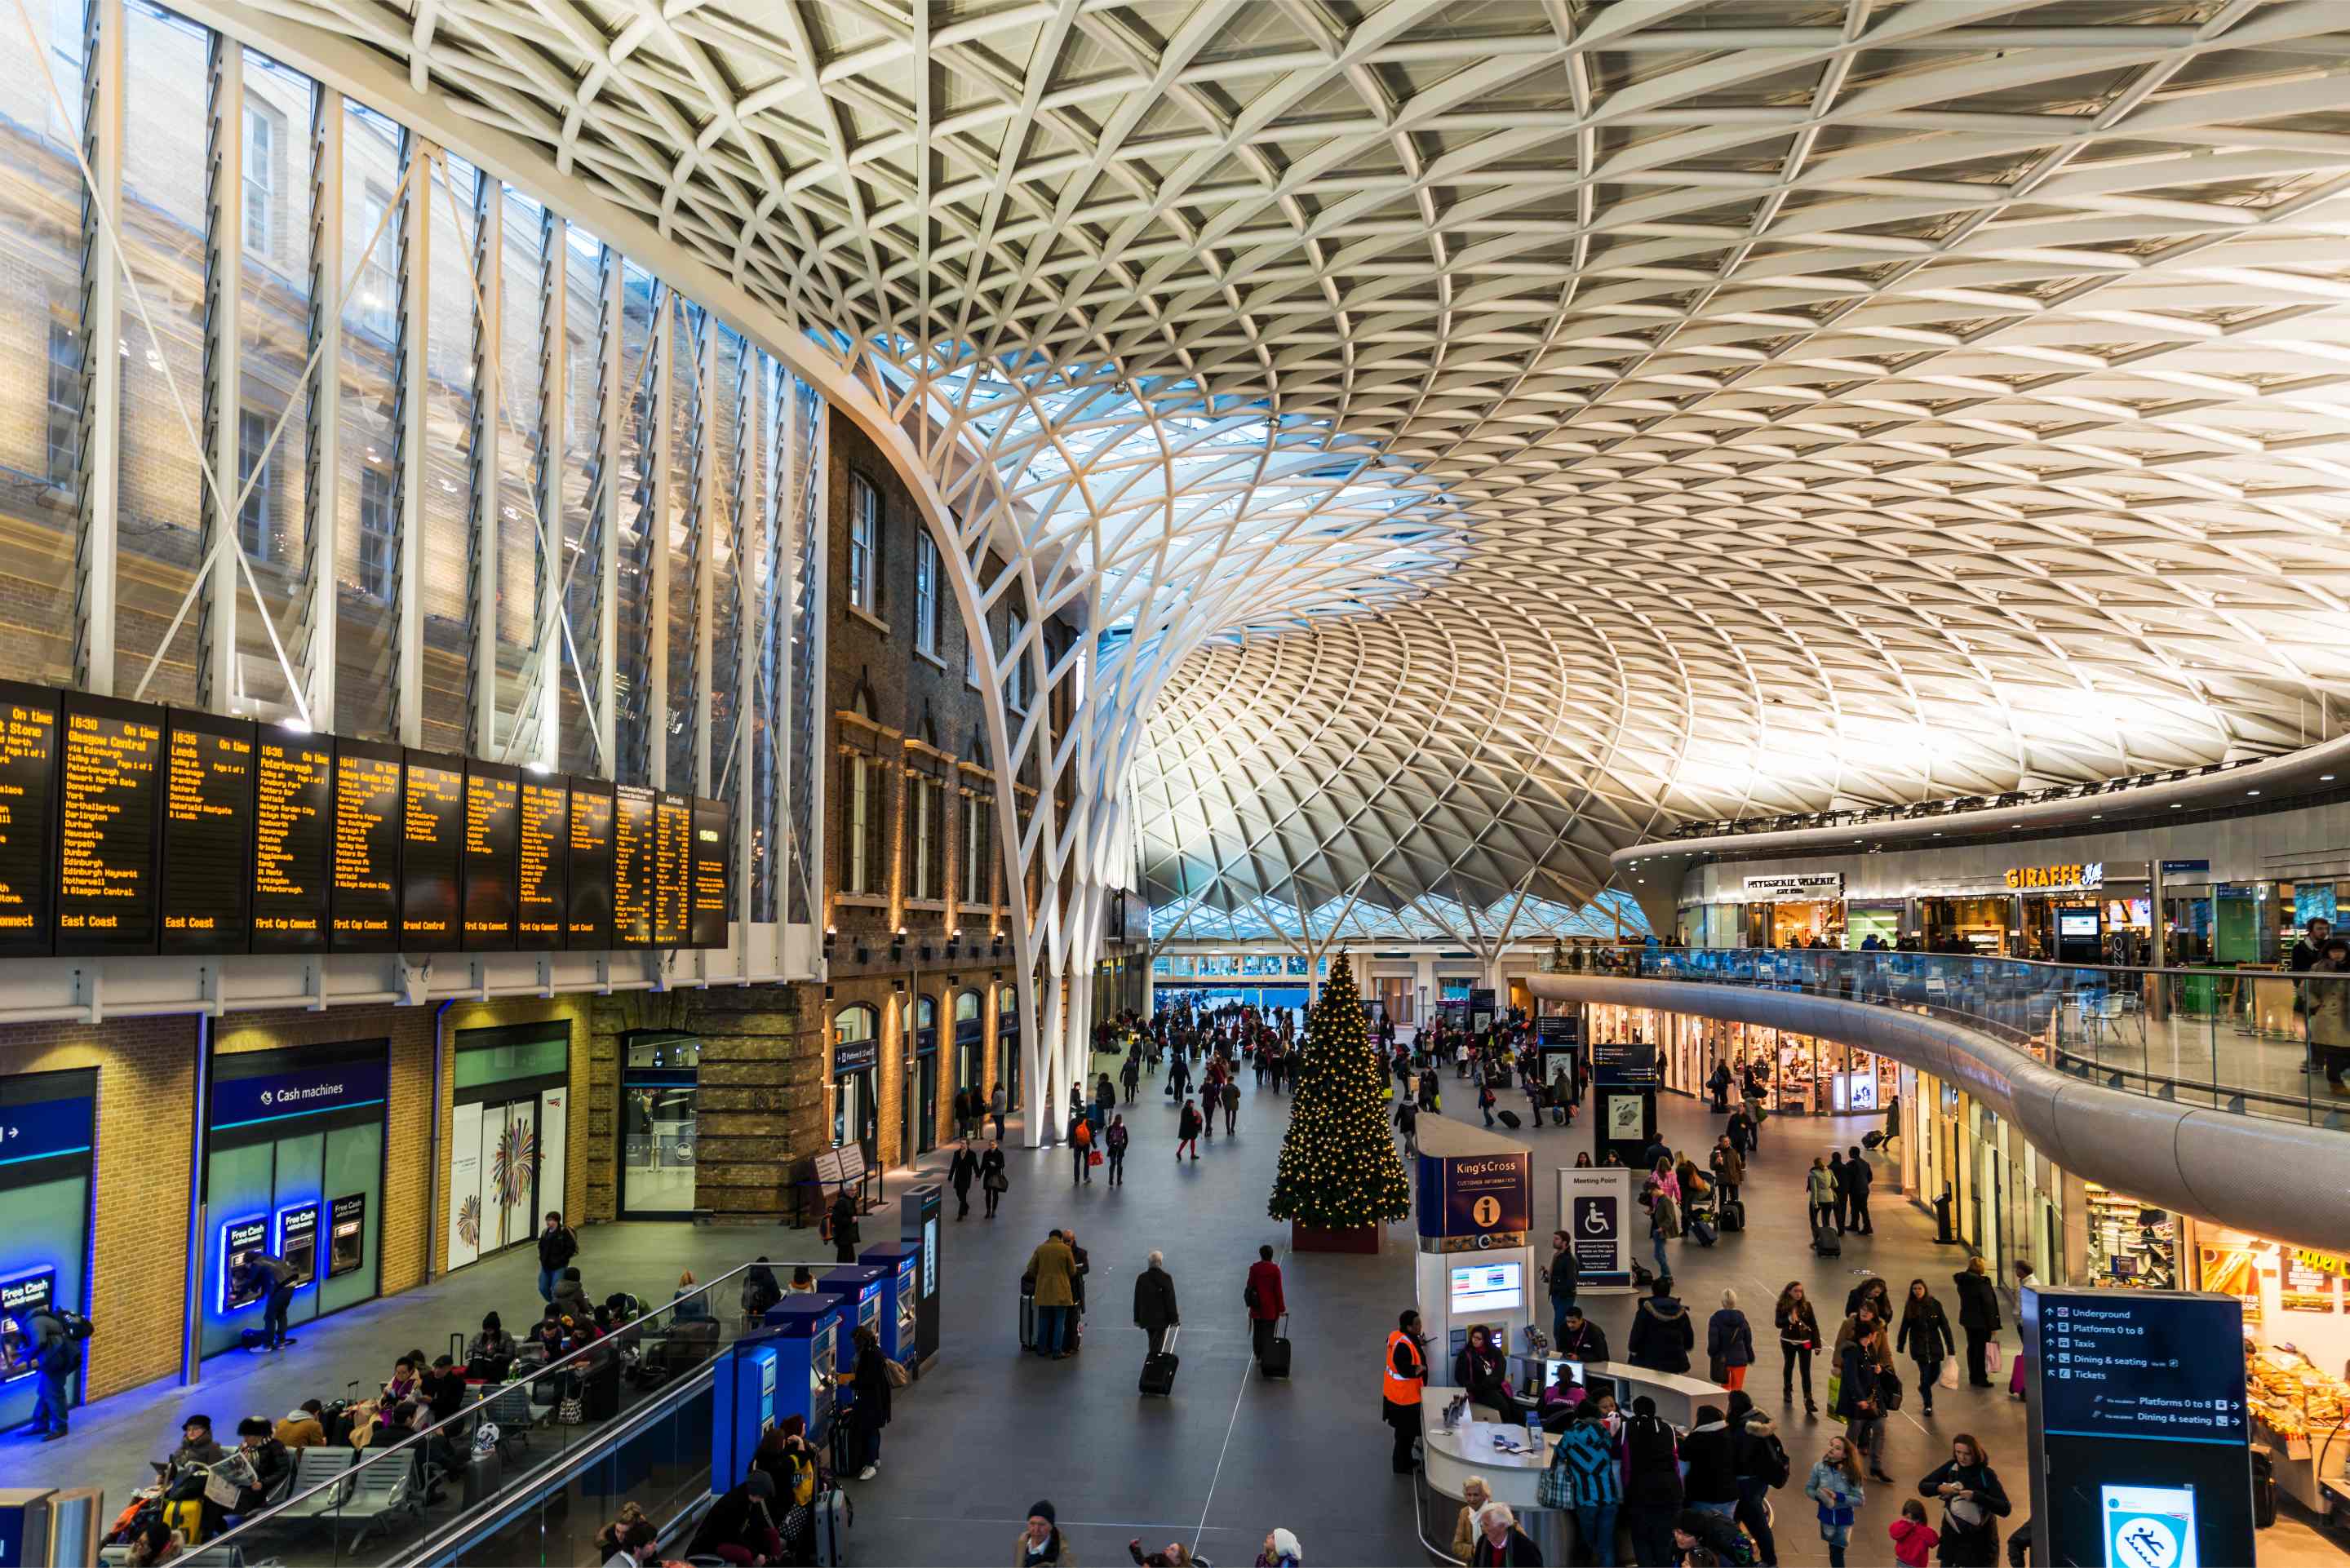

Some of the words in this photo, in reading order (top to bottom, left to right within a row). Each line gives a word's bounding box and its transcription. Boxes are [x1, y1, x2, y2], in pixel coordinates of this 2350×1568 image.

[11, 707, 26, 720] On
[31, 711, 52, 724] time
[9, 723, 42, 737] Stone
[69, 717, 98, 731] 16:30
[124, 724, 136, 736] On
[140, 728, 158, 740] time
[172, 731, 197, 744] 16:35
[68, 730, 107, 746] Glasgow
[109, 737, 146, 751] Central
[219, 738, 230, 750] On
[233, 740, 250, 753] time
[83, 745, 122, 759] Edinburgh
[171, 746, 197, 759] Leeds
[117, 759, 132, 769] Page
[260, 757, 313, 775] Peterborough
[301, 752, 312, 762] On
[313, 754, 330, 767] time
[65, 791, 84, 800] York
[63, 857, 103, 868] Edinburgh
[63, 866, 103, 878] Edinburgh
[2006, 865, 2081, 888] GIRAFFE
[69, 885, 101, 897] Glasgow
[61, 915, 85, 927] East
[88, 915, 118, 928] Coast
[165, 919, 186, 928] East
[188, 919, 214, 928] Coast
[255, 918, 273, 928] First
[275, 918, 288, 928] Cap
[289, 919, 317, 928] Connect
[333, 919, 349, 928] First
[277, 1087, 299, 1102] Cash
[301, 1083, 344, 1099] machines
[1457, 1162, 1486, 1175] King's
[1487, 1161, 1516, 1172] Cross
[335, 1203, 348, 1214] Free
[348, 1200, 361, 1211] Cash
[286, 1215, 300, 1226] Free
[300, 1211, 316, 1221] Cash
[231, 1229, 248, 1240] Free
[247, 1224, 264, 1235] Cash
[2, 1288, 24, 1301] Free
[24, 1279, 48, 1294] Cash
[2073, 1309, 2131, 1319] Underground
[2073, 1324, 2116, 1334] Platforms
[2117, 1326, 2124, 1335] 0
[2126, 1327, 2135, 1335] to
[2137, 1327, 2144, 1335] 8
[2073, 1339, 2095, 1349] Taxis
[2074, 1355, 2104, 1366] Dining
[2105, 1356, 2113, 1364] &
[2114, 1358, 2147, 1368] seating
[2074, 1370, 2106, 1380] Tickets
[2139, 1397, 2183, 1407] Platforms
[2184, 1399, 2191, 1407] 0
[2193, 1400, 2203, 1408] to
[2205, 1400, 2211, 1409] 8
[2138, 1412, 2167, 1423] Dining
[2168, 1414, 2176, 1422] &
[2179, 1415, 2212, 1426] seating
